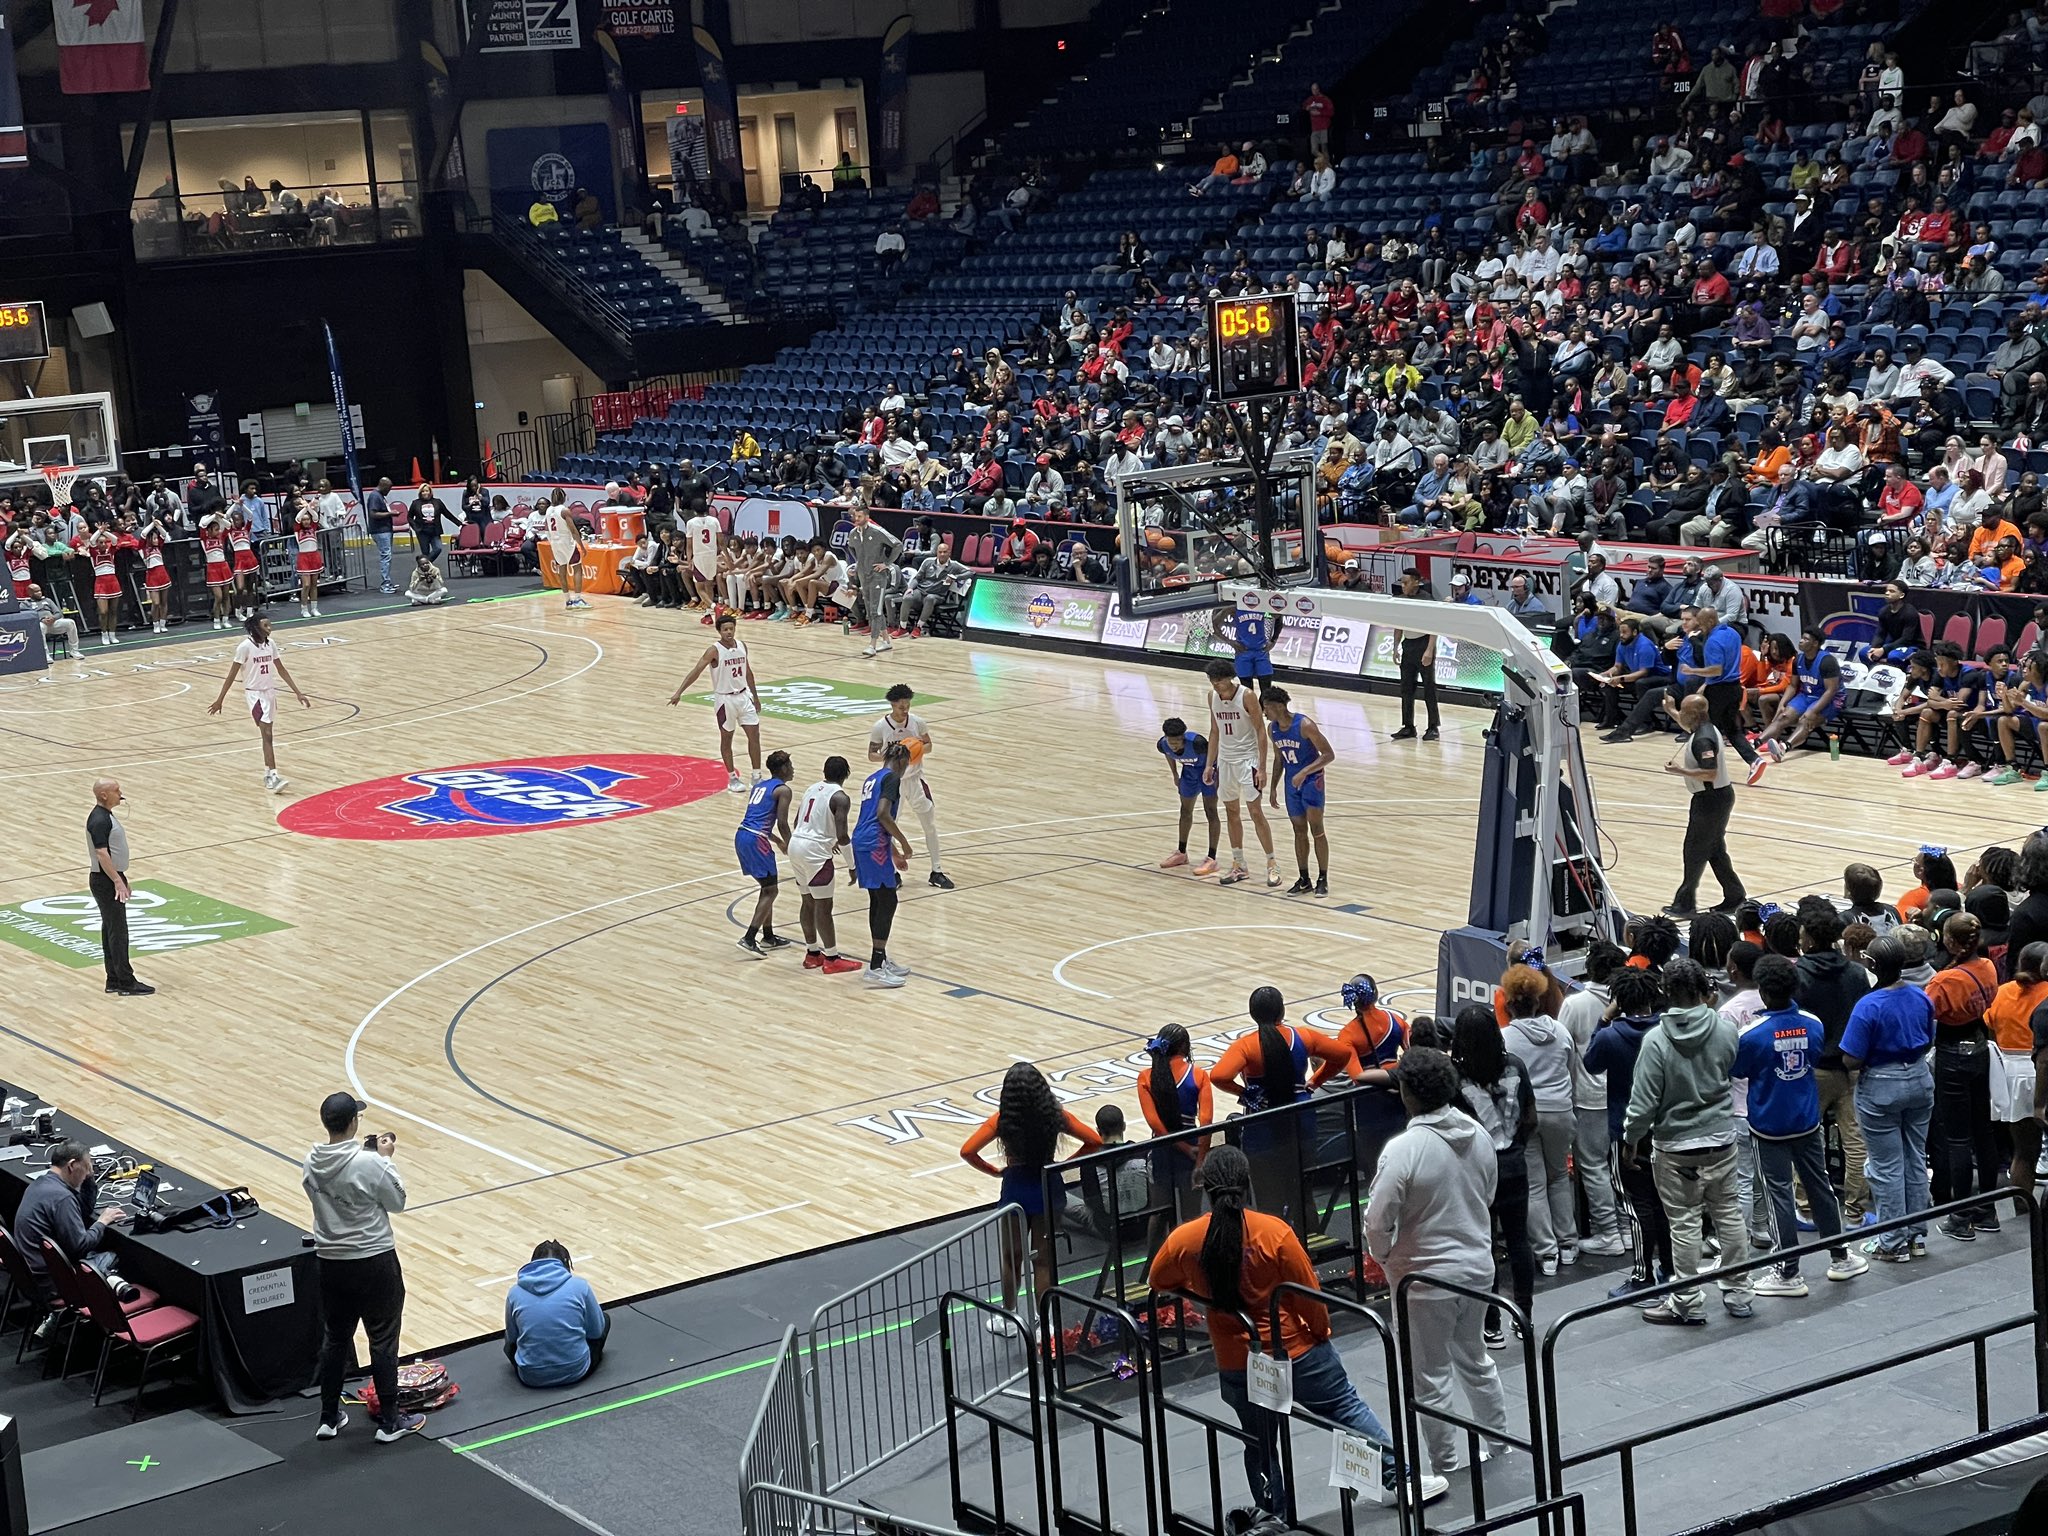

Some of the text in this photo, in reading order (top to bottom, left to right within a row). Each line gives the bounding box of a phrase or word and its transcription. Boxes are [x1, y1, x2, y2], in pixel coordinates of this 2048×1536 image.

[611, 9, 674, 25] GOLF CARTS
[500, 22, 523, 31] PRINT
[661, 24, 675, 33] LLC
[489, 33, 525, 42] PARTNER
[528, 31, 554, 39] SIGNS
[1673, 81, 1691, 92] 206
[1373, 107, 1388, 117] 205
[1428, 102, 1442, 113] 206
[1276, 114, 1290, 124] 205
[1221, 306, 1270, 337] 05.6
[550, 517, 557, 532] 2
[619, 518, 628, 530] G
[702, 529, 710, 544] 3
[1104, 619, 1146, 638] FAN
[1282, 615, 1321, 629] NDY CREE
[1158, 623, 1179, 643] 22
[1249, 623, 1257, 635] 4
[1321, 626, 1350, 643] GO
[0, 632, 26, 646] SA
[1282, 637, 1303, 658] 41
[1316, 643, 1363, 664] FAN
[260, 664, 269, 675] 21
[731, 666, 743, 678] 24
[1840, 669, 1858, 678] HSA
[1216, 712, 1241, 720] PATRIOTS
[1224, 723, 1233, 735] 11
[1282, 751, 1298, 764] 14
[416, 771, 630, 818] GHSA
[749, 787, 767, 805] 10
[804, 798, 816, 823] 1
[1775, 1028, 1807, 1039] DAMINE
[255, 1272, 278, 1282] MEDIA
[248, 1282, 287, 1295] CREDENTIAL
[252, 1292, 285, 1306] REQUIRED
[1252, 1359, 1265, 1371] DO
[1256, 1376, 1279, 1394] ENTER
[1342, 1441, 1374, 1474] DO NOT
[1345, 1470, 1370, 1499] ENTER
